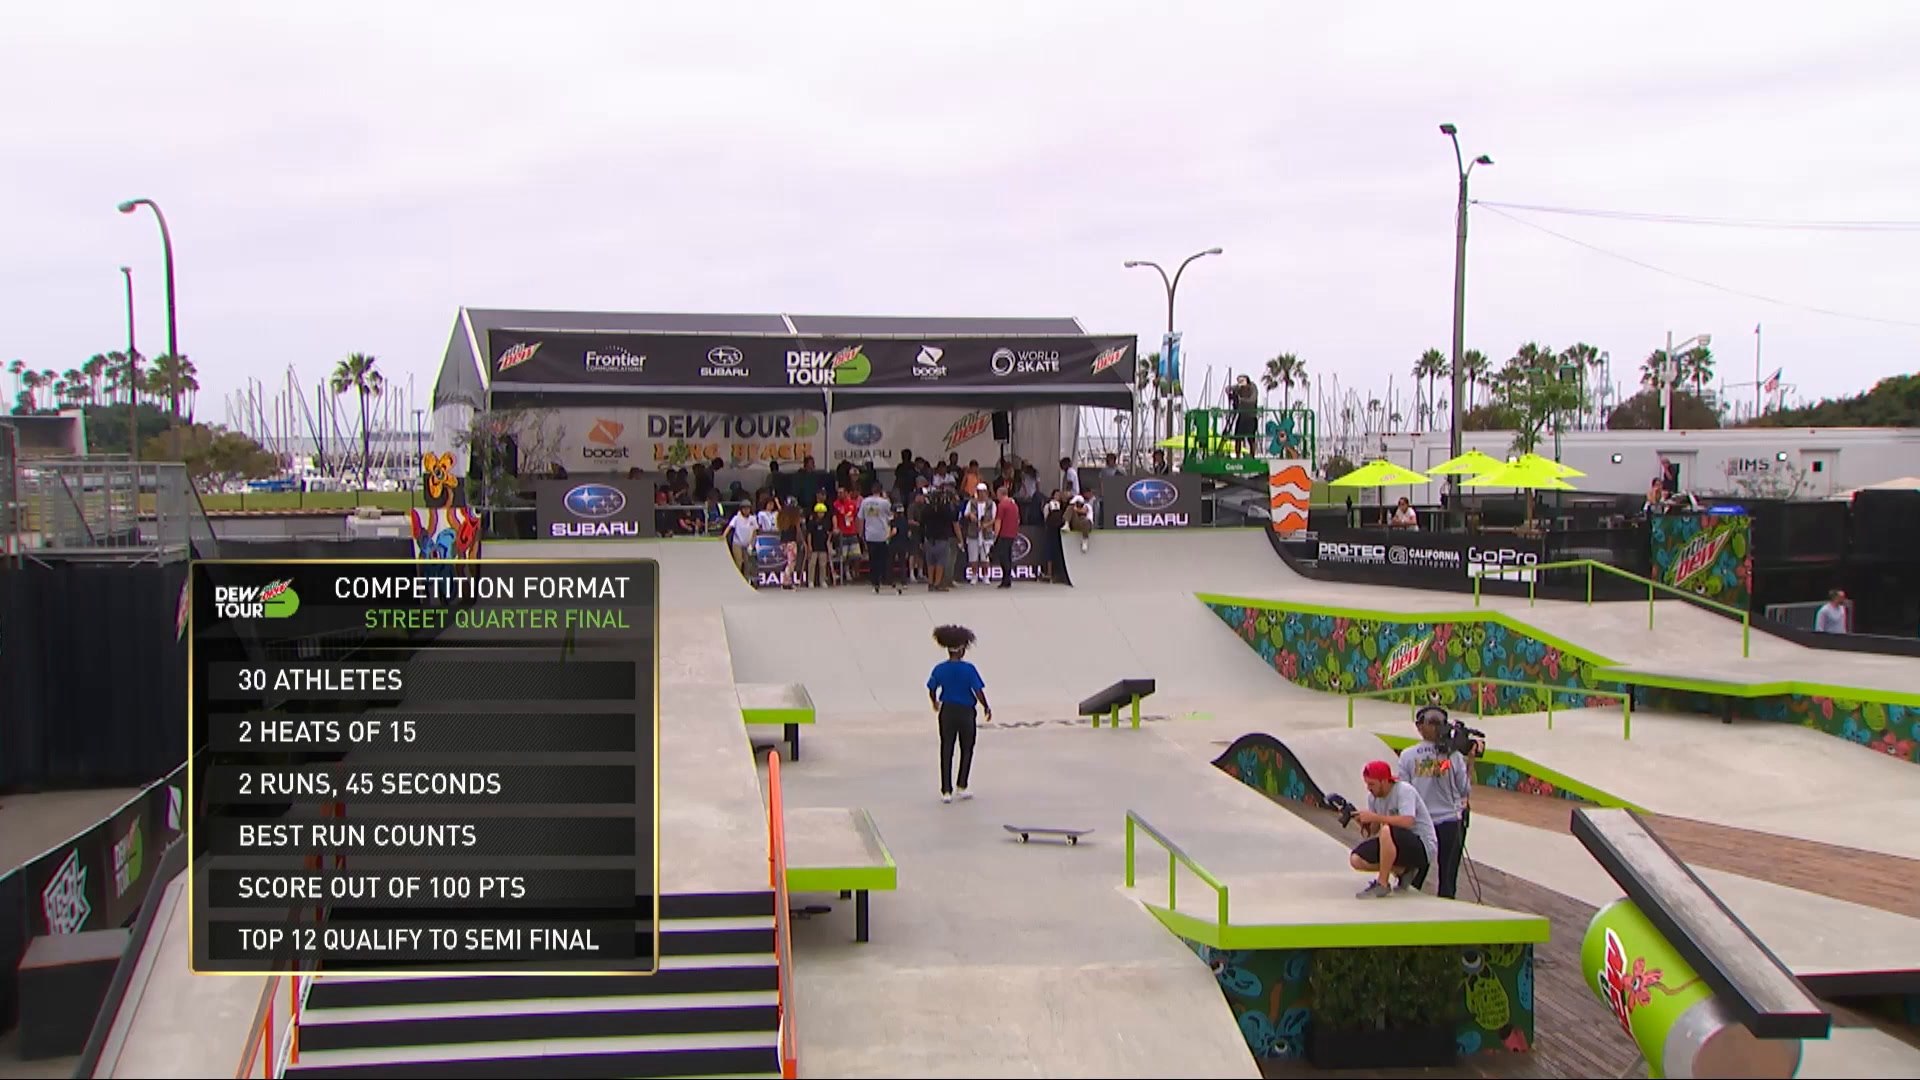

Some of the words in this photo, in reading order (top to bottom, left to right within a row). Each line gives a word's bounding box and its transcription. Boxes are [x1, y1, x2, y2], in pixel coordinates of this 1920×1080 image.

[586, 350, 646, 367] Frontier
[787, 351, 833, 367] DEW
[1018, 351, 1059, 361] WORLD
[701, 368, 749, 377] SUBARU
[913, 365, 947, 377] boost
[1018, 361, 1060, 373] SKATE
[787, 367, 835, 385] TOUR
[648, 415, 717, 438] DEW
[720, 415, 791, 438] TOUR
[583, 446, 629, 458] boost
[834, 449, 892, 460] SUBARU
[1739, 458, 1770, 472] IMS
[1116, 513, 1190, 527] SUBARU
[552, 521, 639, 537] SUBARU
[1319, 543, 1386, 557] PRO-TEC
[1409, 550, 1460, 561] CALIFORNIA
[1468, 547, 1538, 565] GoPro
